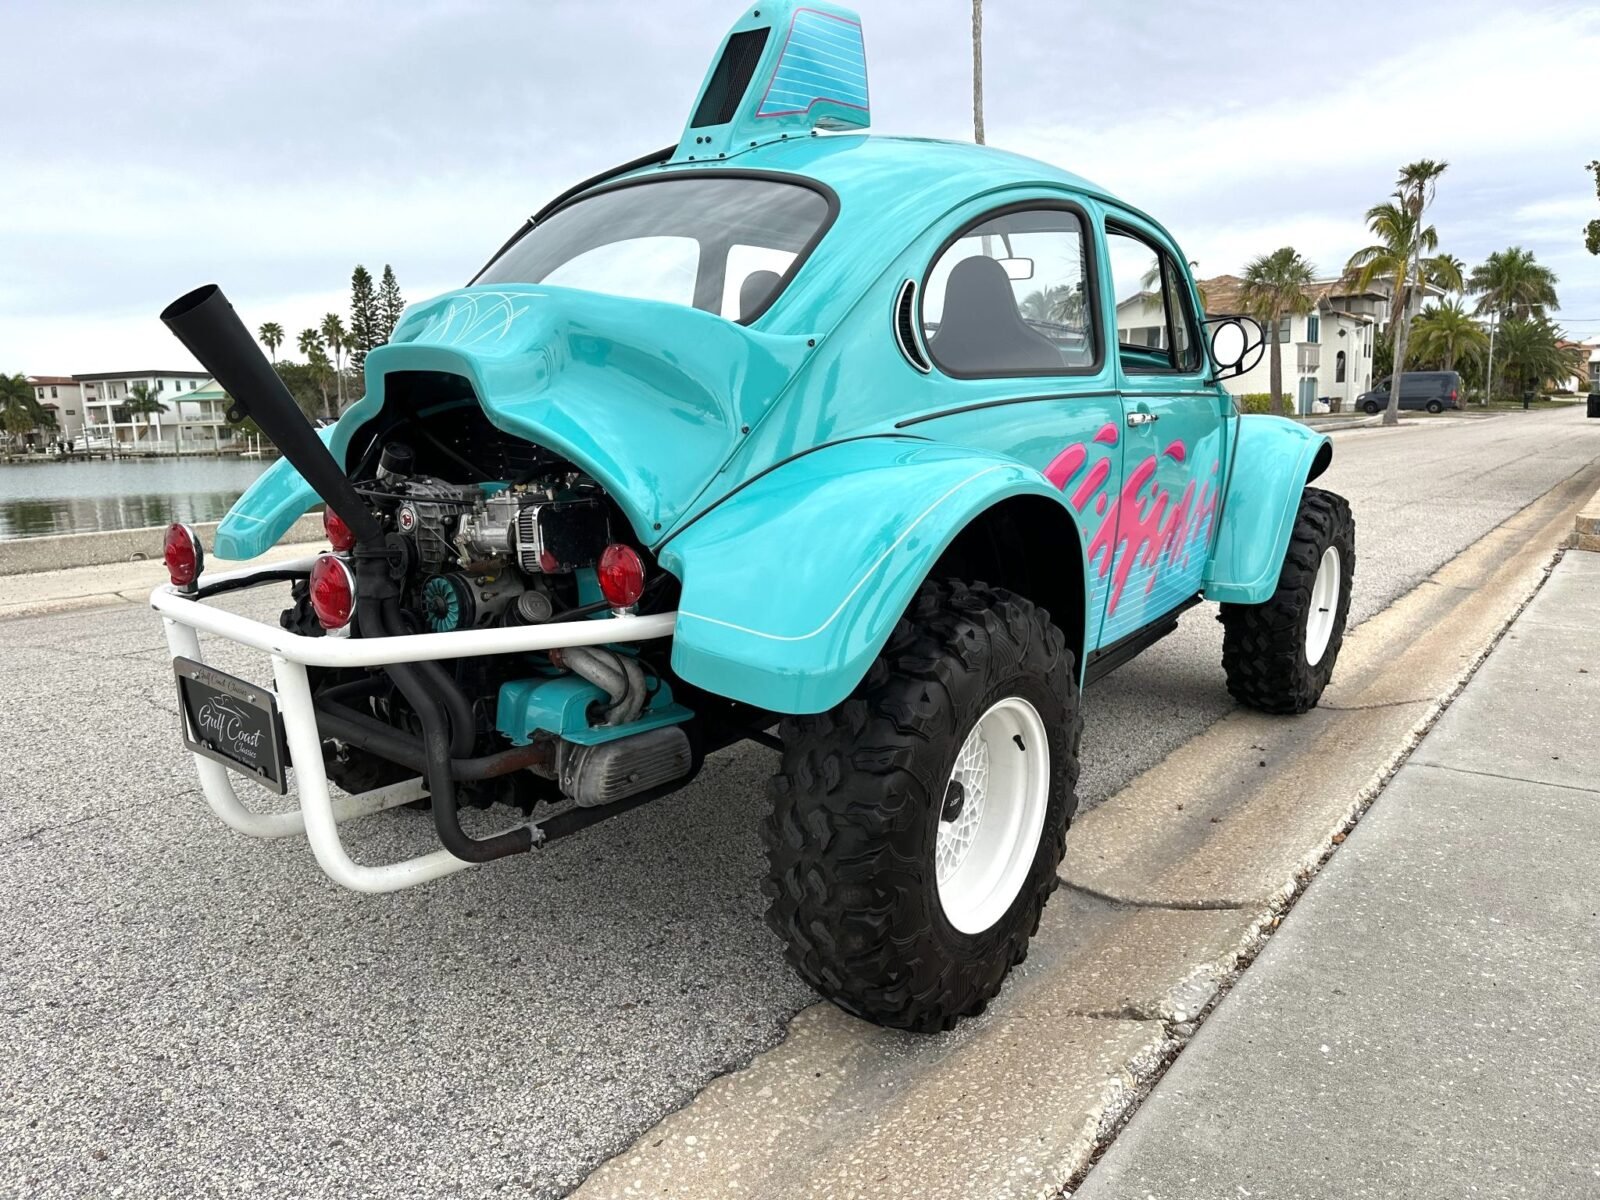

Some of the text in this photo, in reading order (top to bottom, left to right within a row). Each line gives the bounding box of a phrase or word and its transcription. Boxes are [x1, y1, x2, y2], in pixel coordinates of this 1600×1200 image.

[198, 704, 265, 748] Gulf Coast
[233, 741, 257, 759] Classics
